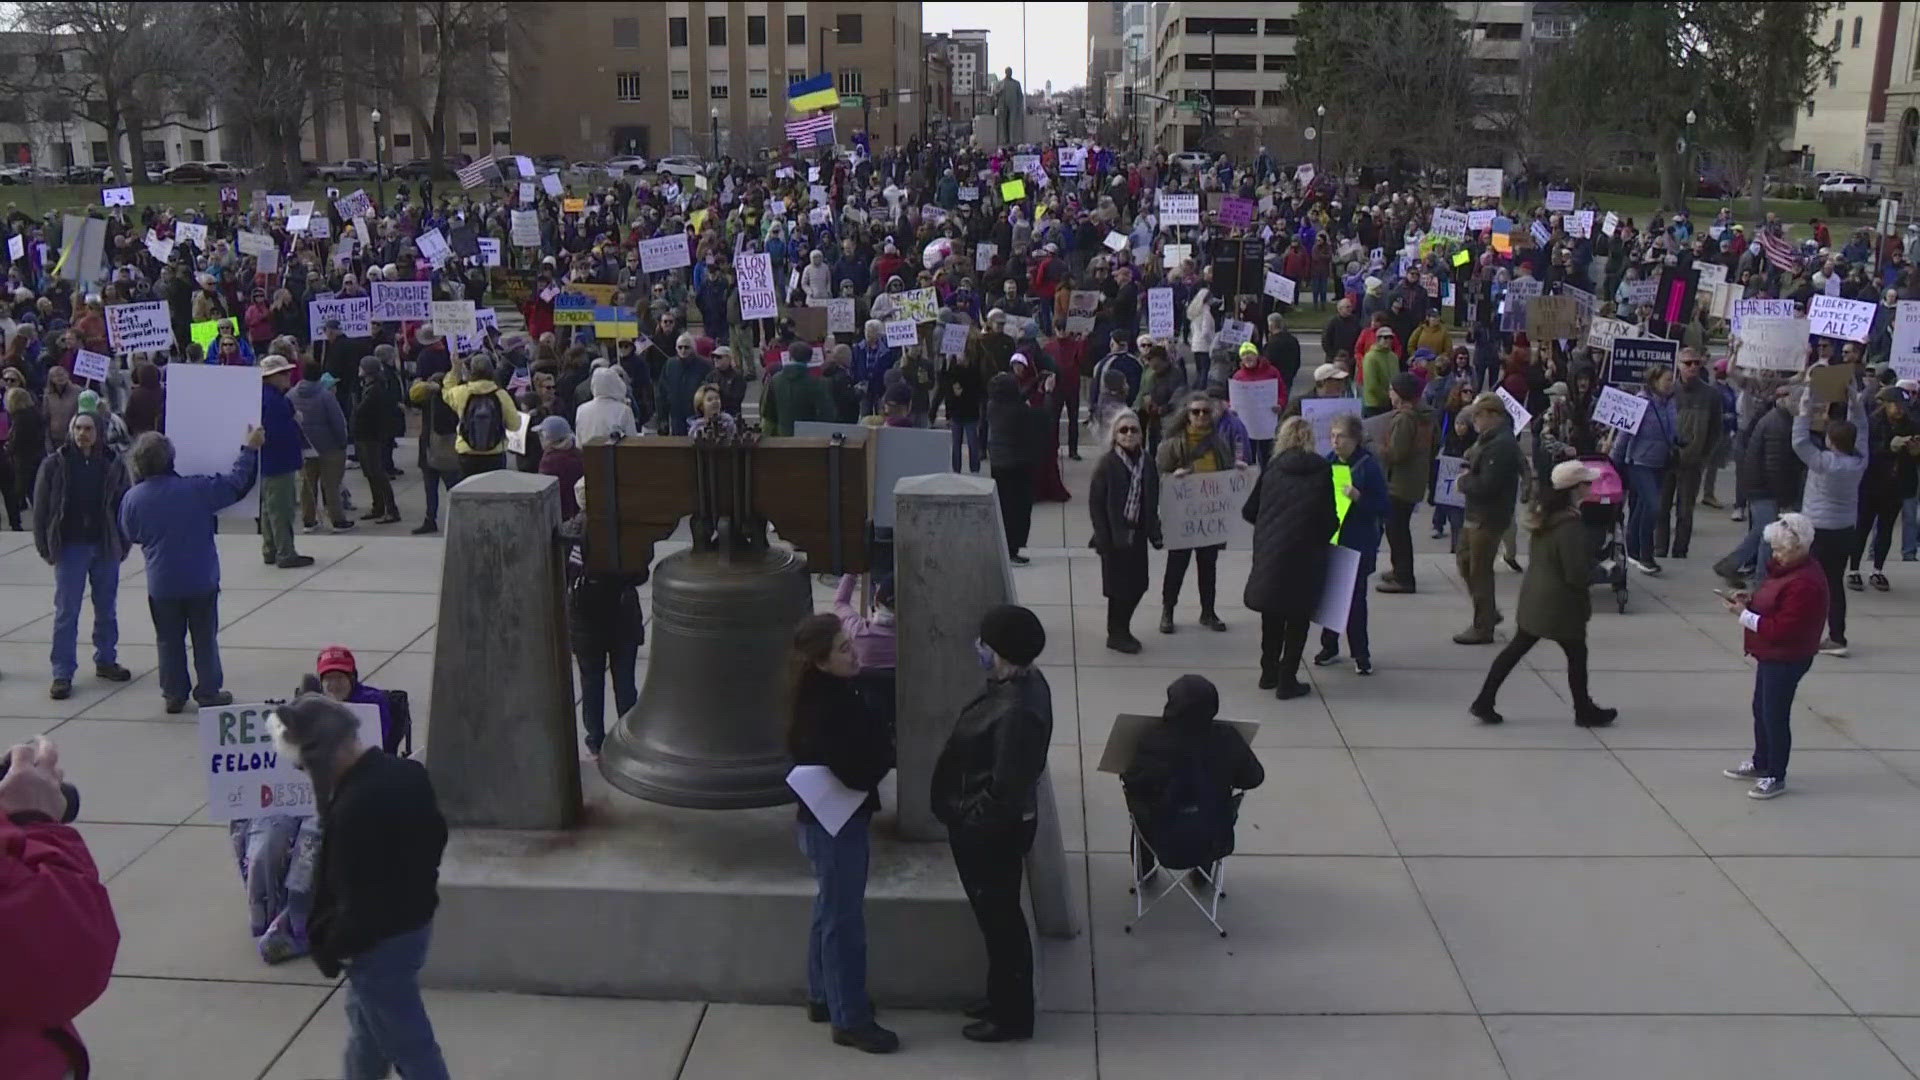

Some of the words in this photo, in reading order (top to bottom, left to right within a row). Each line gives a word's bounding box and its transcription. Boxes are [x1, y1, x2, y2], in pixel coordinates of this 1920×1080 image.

[737, 256, 766, 270] ELON
[739, 269, 767, 281] MUSK
[756, 279, 767, 289] THE
[377, 284, 429, 302] DOUCHE
[742, 292, 776, 310] FRAUD!
[317, 303, 345, 314] WAKE
[350, 299, 369, 313] UP!
[385, 302, 429, 318] DOGE!
[1734, 300, 1760, 316] FEAR
[1815, 297, 1857, 311] LIBERTY
[1810, 309, 1851, 321] JUSTICE
[1853, 315, 1871, 323] FOR
[1608, 322, 1630, 336] TAX
[1823, 320, 1859, 338] ALL?
[1615, 349, 1627, 358] I'M
[1629, 350, 1634, 358] A
[1605, 391, 1641, 408] NOBODY
[1609, 412, 1636, 430] LAW
[1173, 482, 1192, 500] WE
[1183, 518, 1229, 537] BACK
[219, 709, 272, 746] RES
[211, 751, 278, 774] FELON
[228, 786, 242, 802] of
